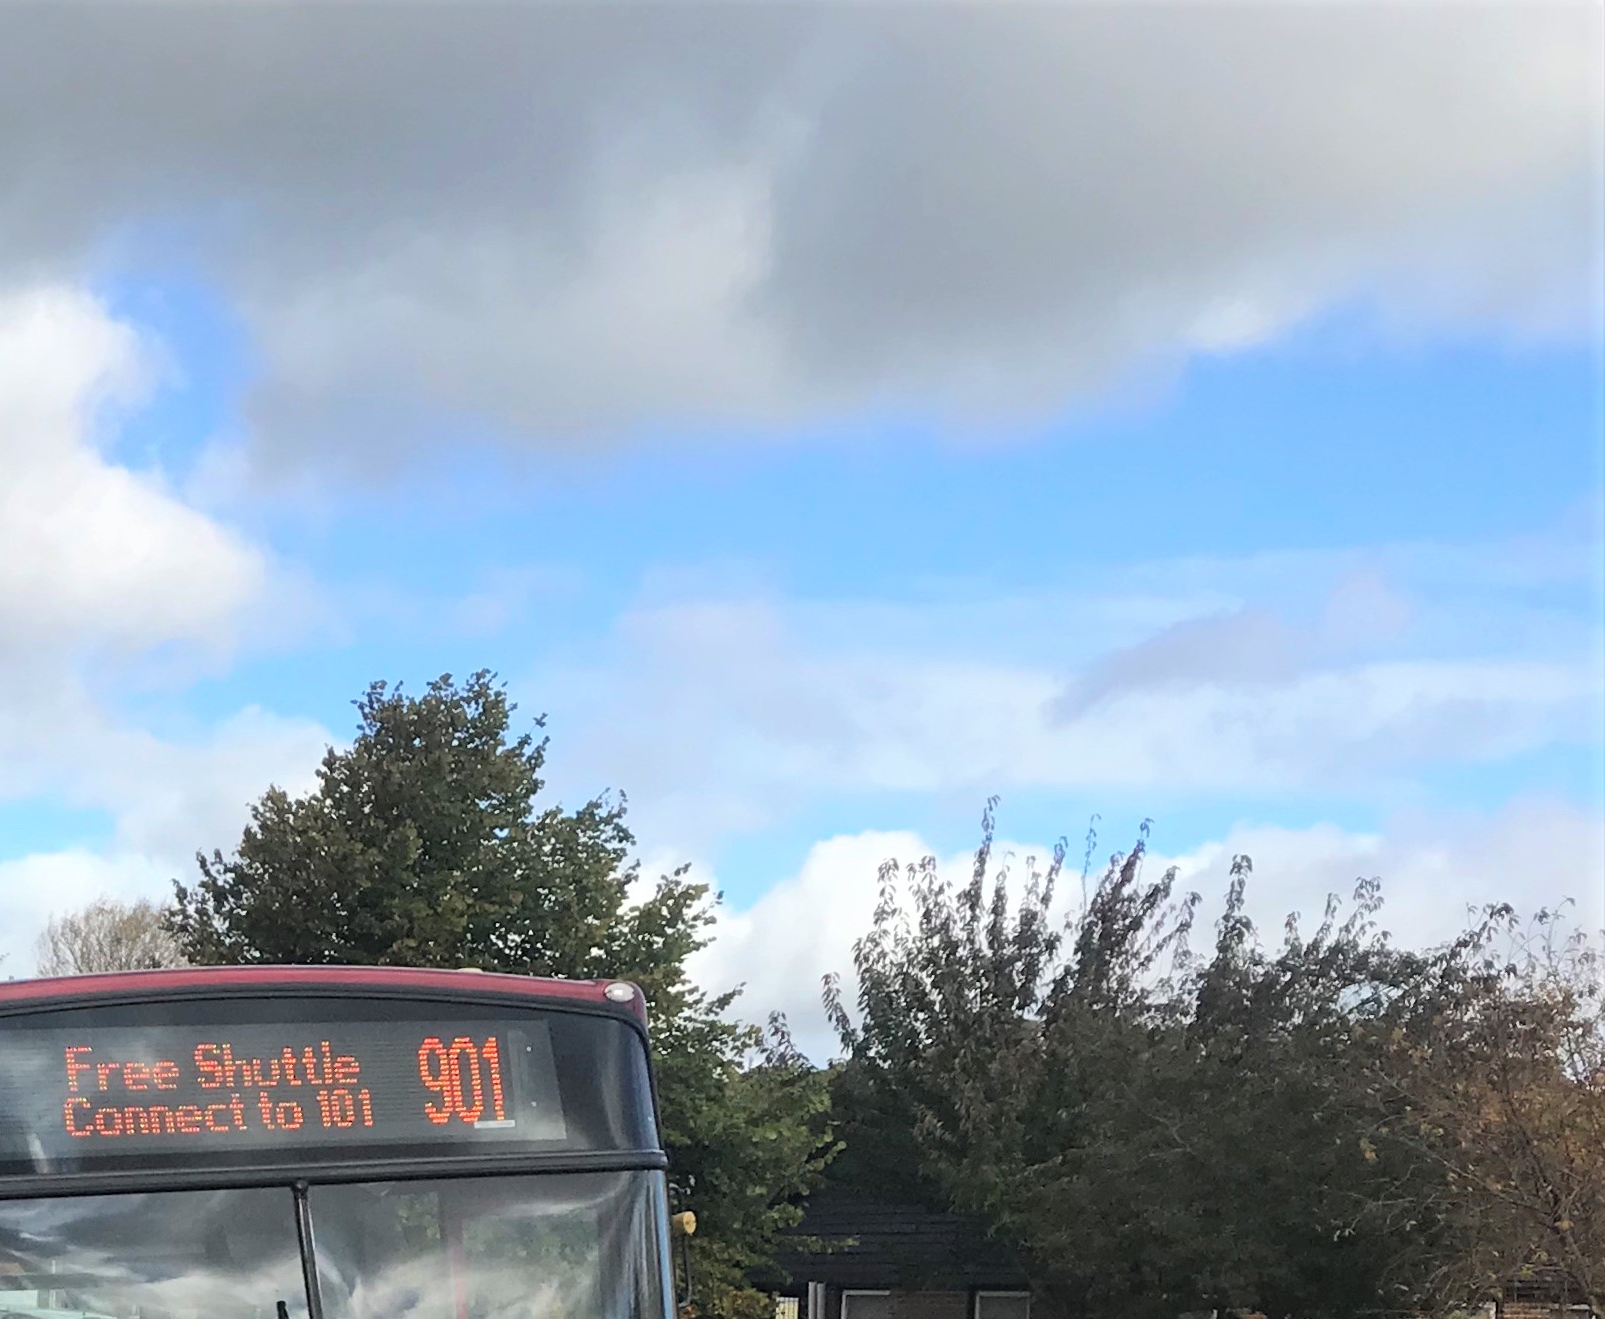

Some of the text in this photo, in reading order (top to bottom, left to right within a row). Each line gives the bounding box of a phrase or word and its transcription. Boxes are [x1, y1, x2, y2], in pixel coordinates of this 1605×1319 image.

[64, 1040, 361, 1092] Free Shuttle
[418, 1036, 506, 1125] 901
[63, 1088, 374, 1138] Connect to 101
